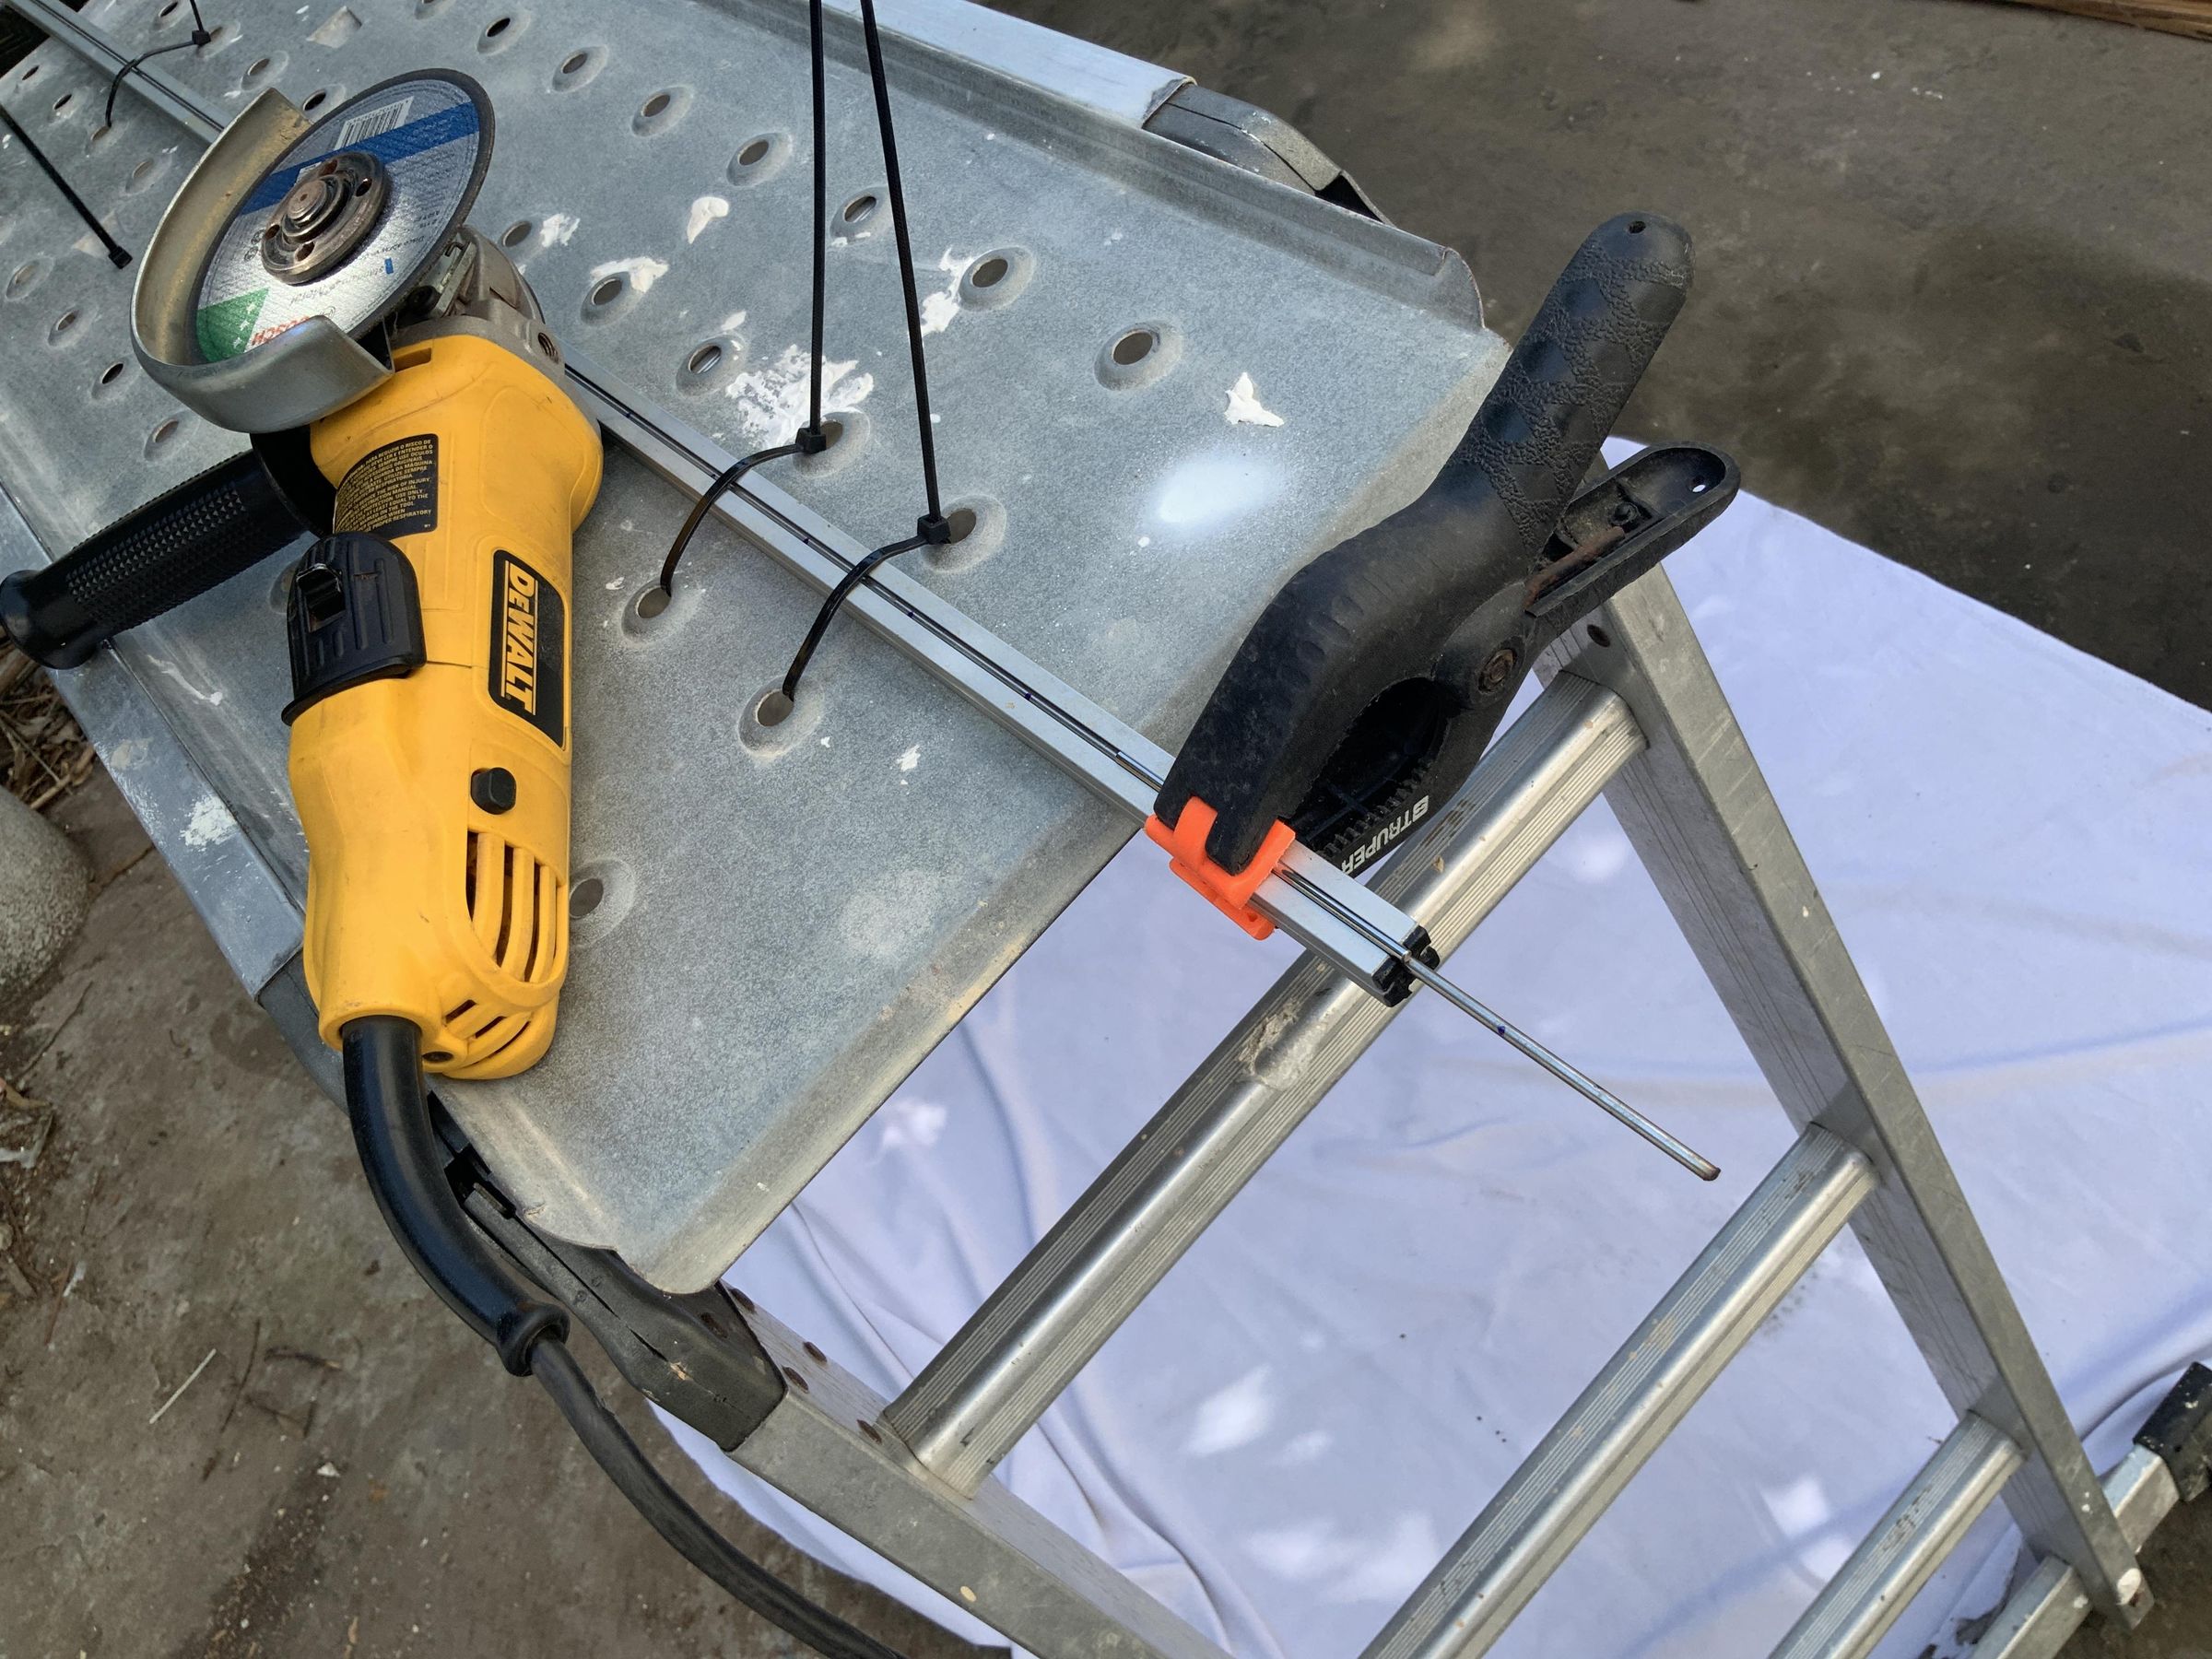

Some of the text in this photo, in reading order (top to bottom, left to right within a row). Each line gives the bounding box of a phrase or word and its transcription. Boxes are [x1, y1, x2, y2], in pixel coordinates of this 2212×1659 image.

[398, 445, 428, 455] ENTENDER
[393, 509, 431, 521] RESPIRATORY
[506, 563, 535, 712] DEWALT
